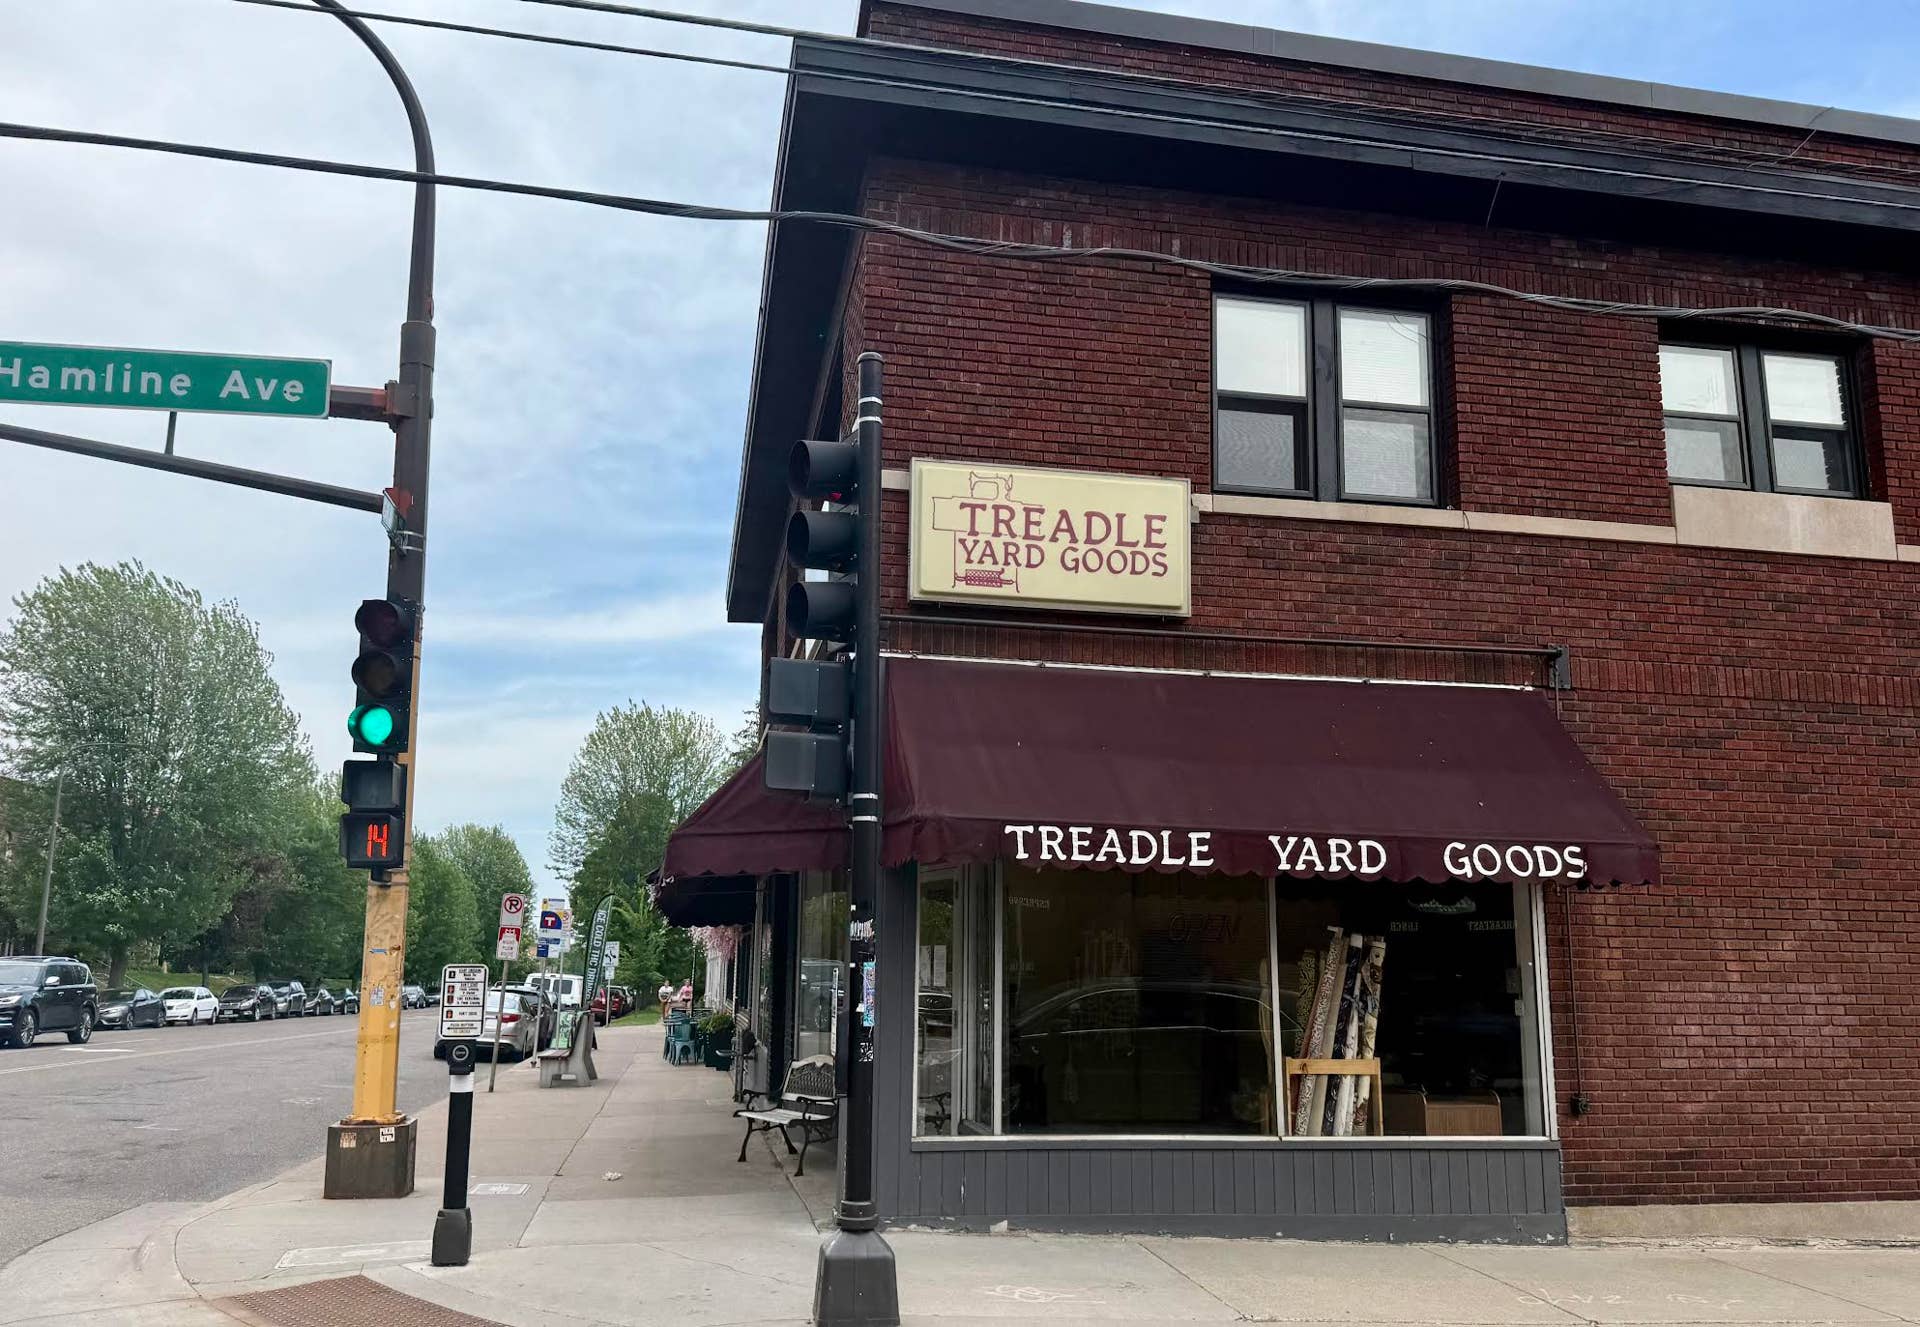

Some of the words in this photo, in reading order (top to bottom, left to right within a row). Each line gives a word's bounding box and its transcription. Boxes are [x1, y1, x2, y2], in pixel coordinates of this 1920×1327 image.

[0, 357, 192, 396] Hamline
[219, 370, 305, 402] Ave
[959, 502, 1168, 549] TREADLE
[958, 538, 1045, 569] YARD
[1060, 547, 1169, 577] GOODS
[366, 823, 388, 858] 14
[1004, 824, 1215, 868] TREADLE
[1268, 835, 1387, 874] YARD
[1442, 841, 1588, 880] GOODS
[592, 925, 605, 947] COLD
[589, 950, 601, 967] THC
